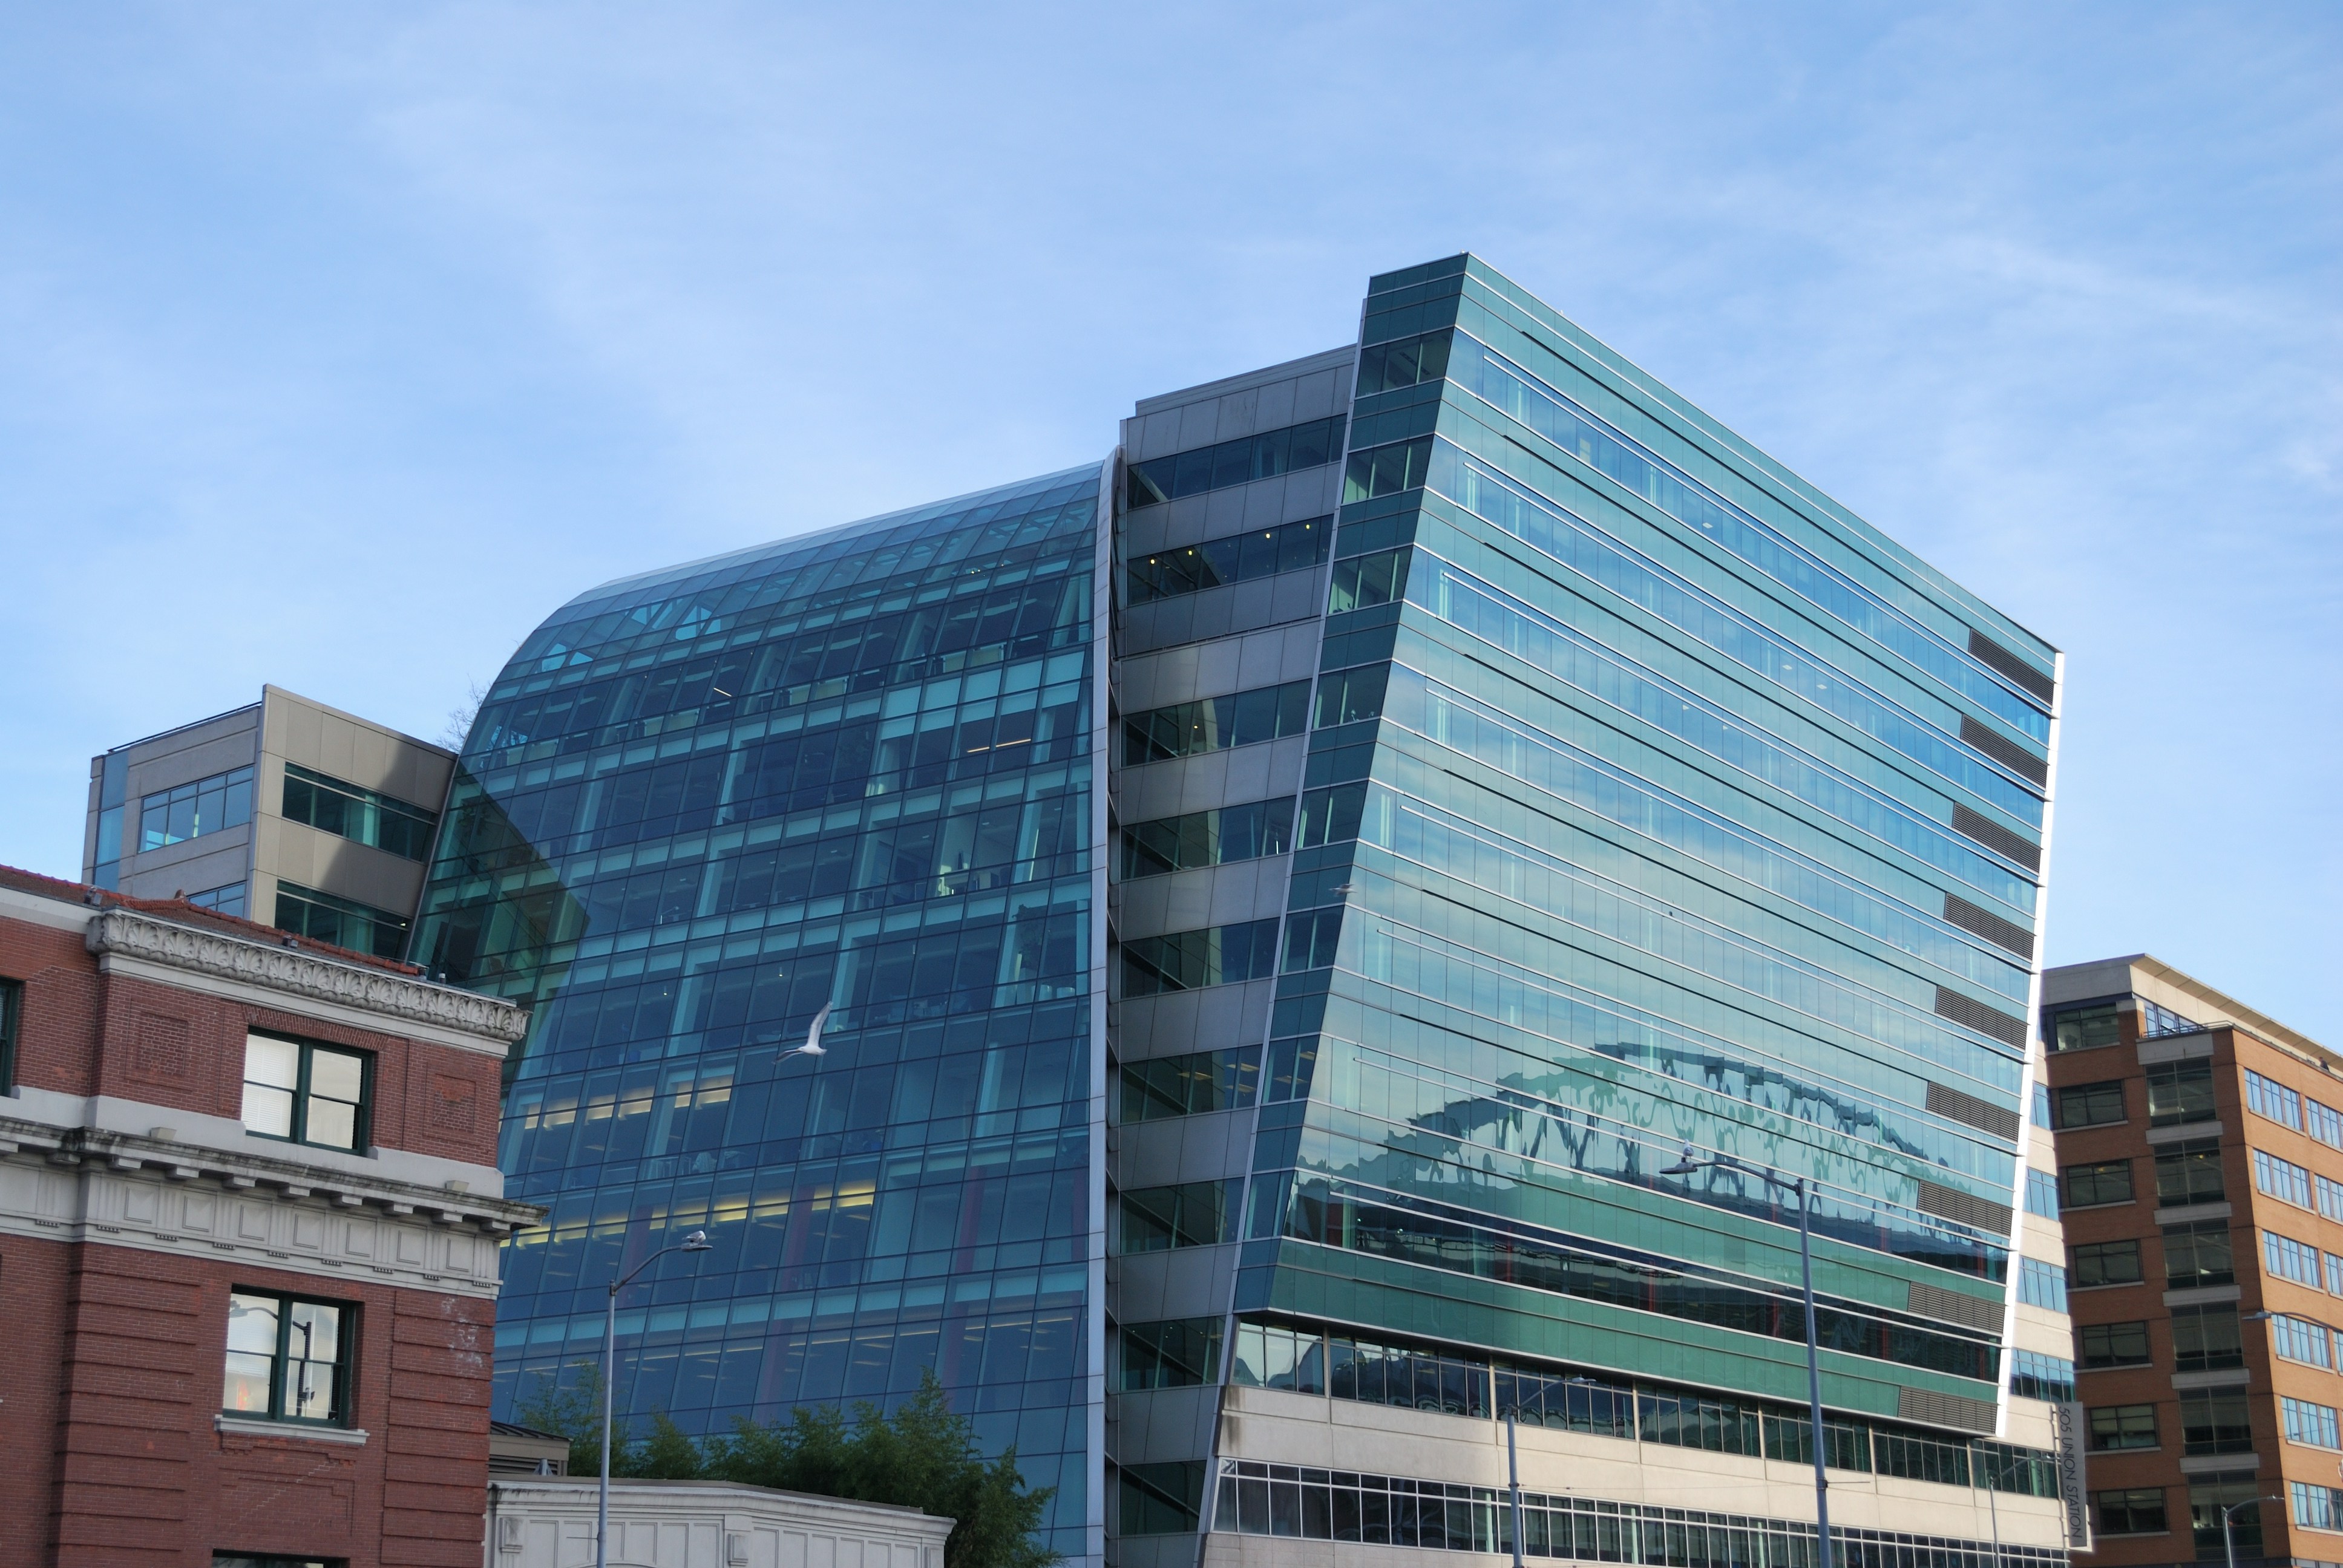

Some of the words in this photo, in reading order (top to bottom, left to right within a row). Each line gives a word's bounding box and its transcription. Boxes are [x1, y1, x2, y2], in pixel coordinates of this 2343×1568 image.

[2059, 1406, 2072, 1432] 505
[2062, 1437, 2077, 1480] UNION
[2066, 1485, 2083, 1538] STATION
